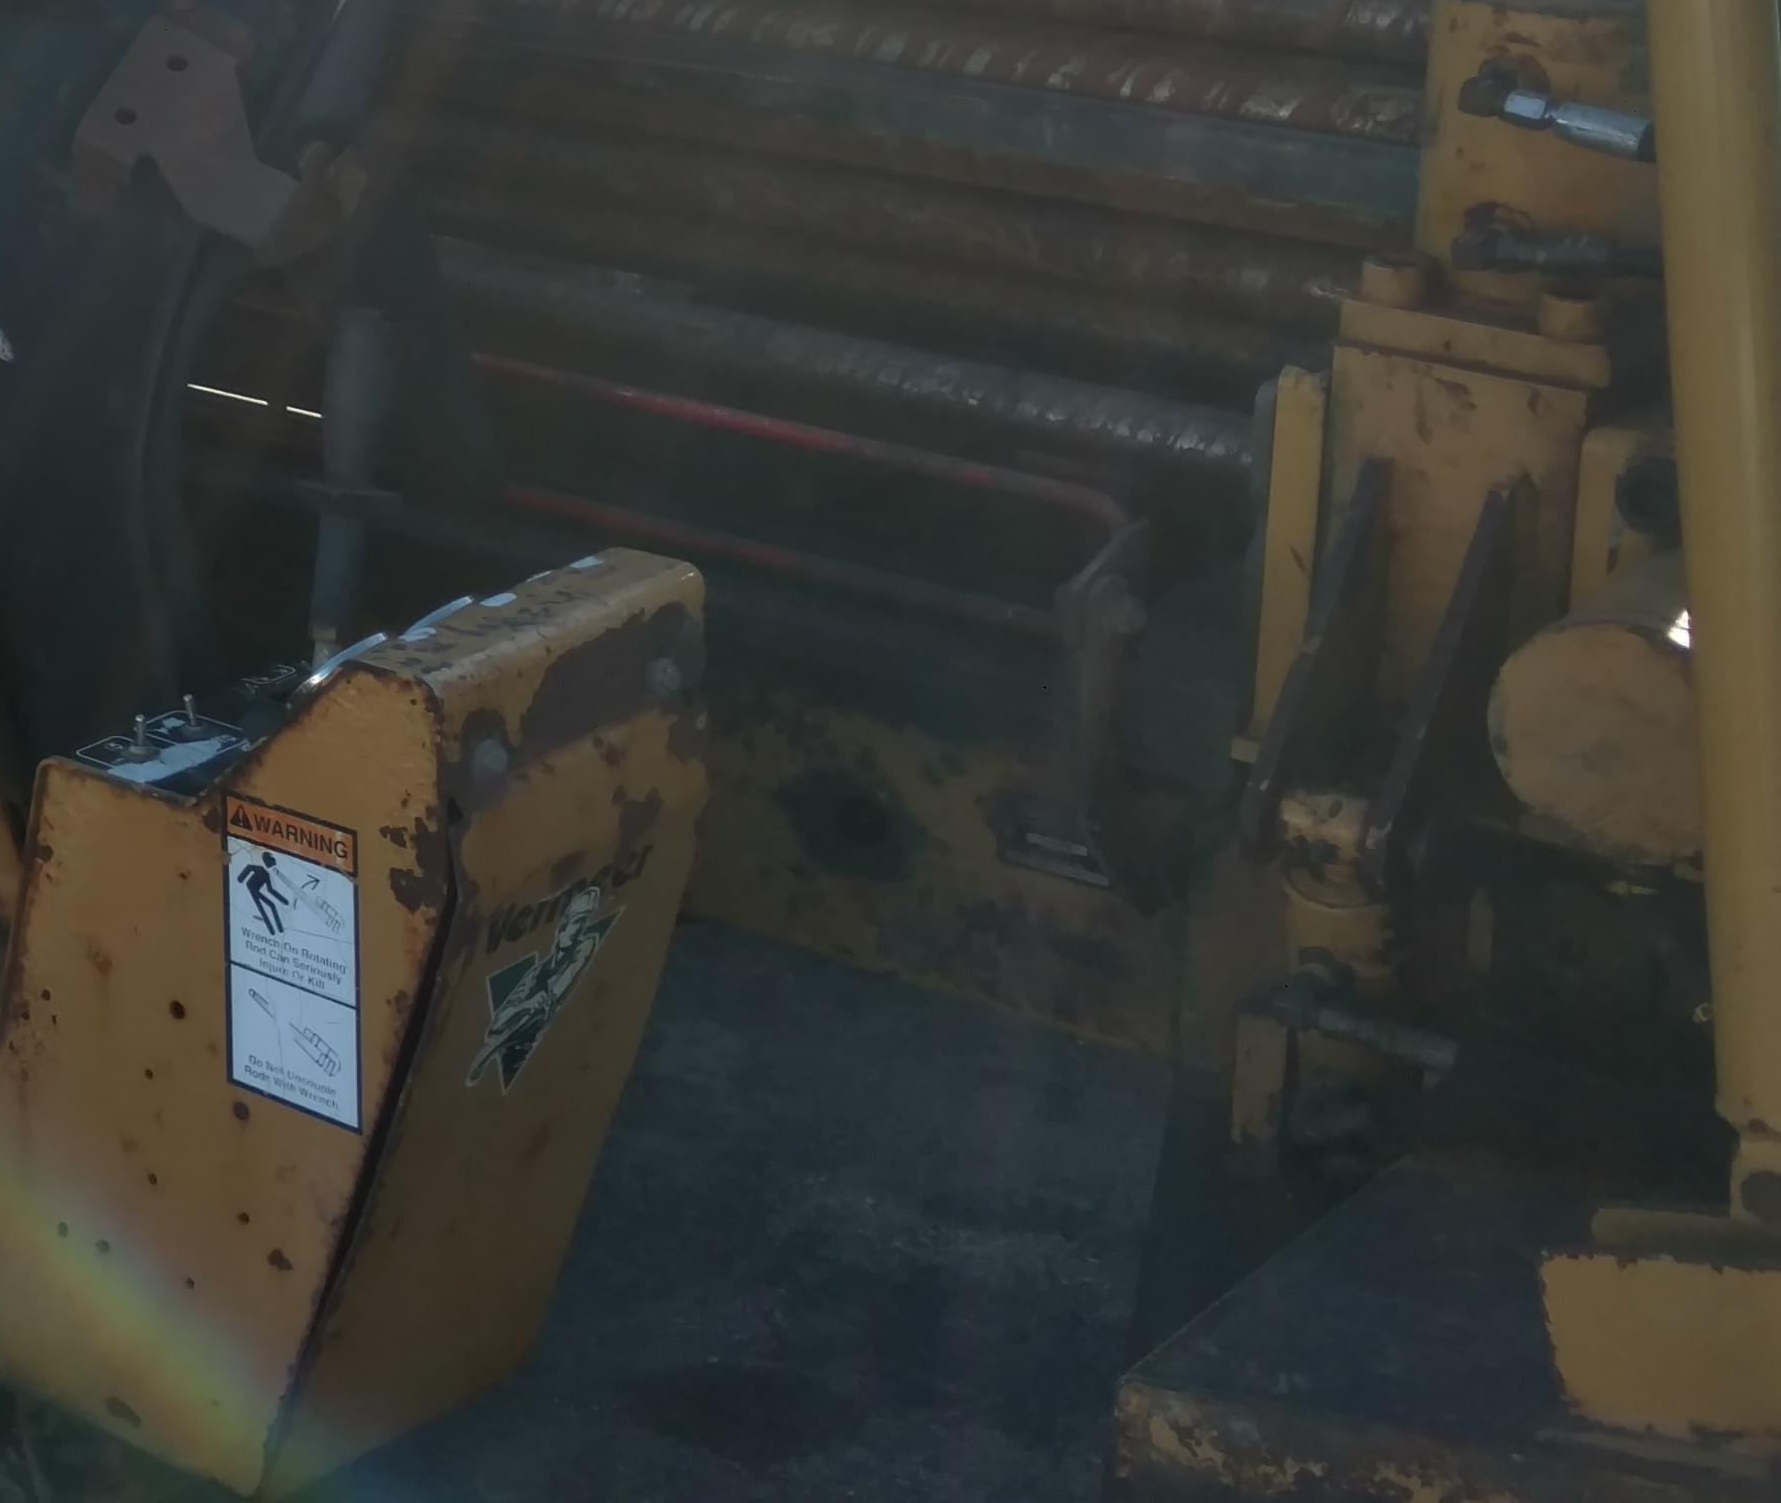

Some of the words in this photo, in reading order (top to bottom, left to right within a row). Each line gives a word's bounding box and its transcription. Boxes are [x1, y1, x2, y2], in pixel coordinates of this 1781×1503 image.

[253, 814, 349, 859] WARNING
[241, 926, 280, 949] Wrench
[301, 948, 347, 975] Rotating
[245, 940, 267, 956] Rod
[268, 948, 290, 964] Can
[293, 957, 343, 986] Seriously
[259, 958, 287, 977] Injure
[307, 975, 325, 990] Kill
[248, 1054, 263, 1068] Do
[273, 1076, 296, 1092] With
